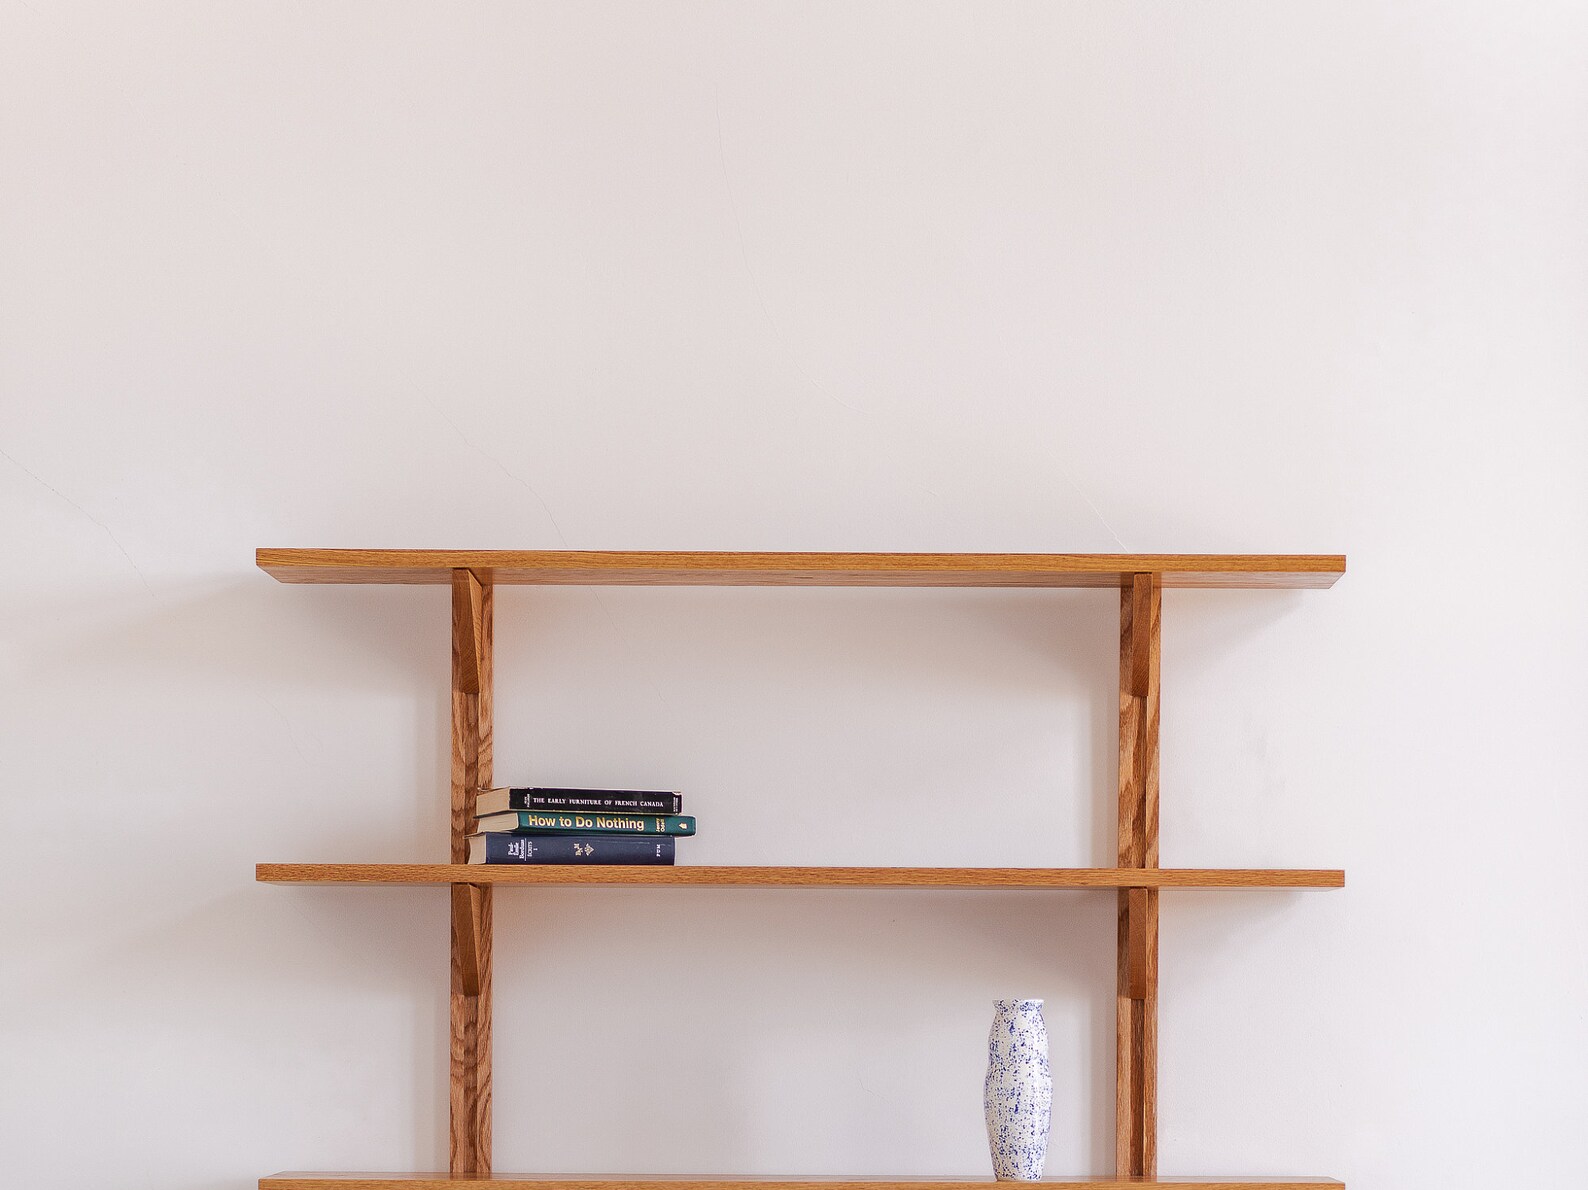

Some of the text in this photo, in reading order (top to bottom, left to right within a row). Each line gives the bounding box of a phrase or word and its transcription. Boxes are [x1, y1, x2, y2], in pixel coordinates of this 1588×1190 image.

[528, 814, 645, 832] How to Do Nothing
